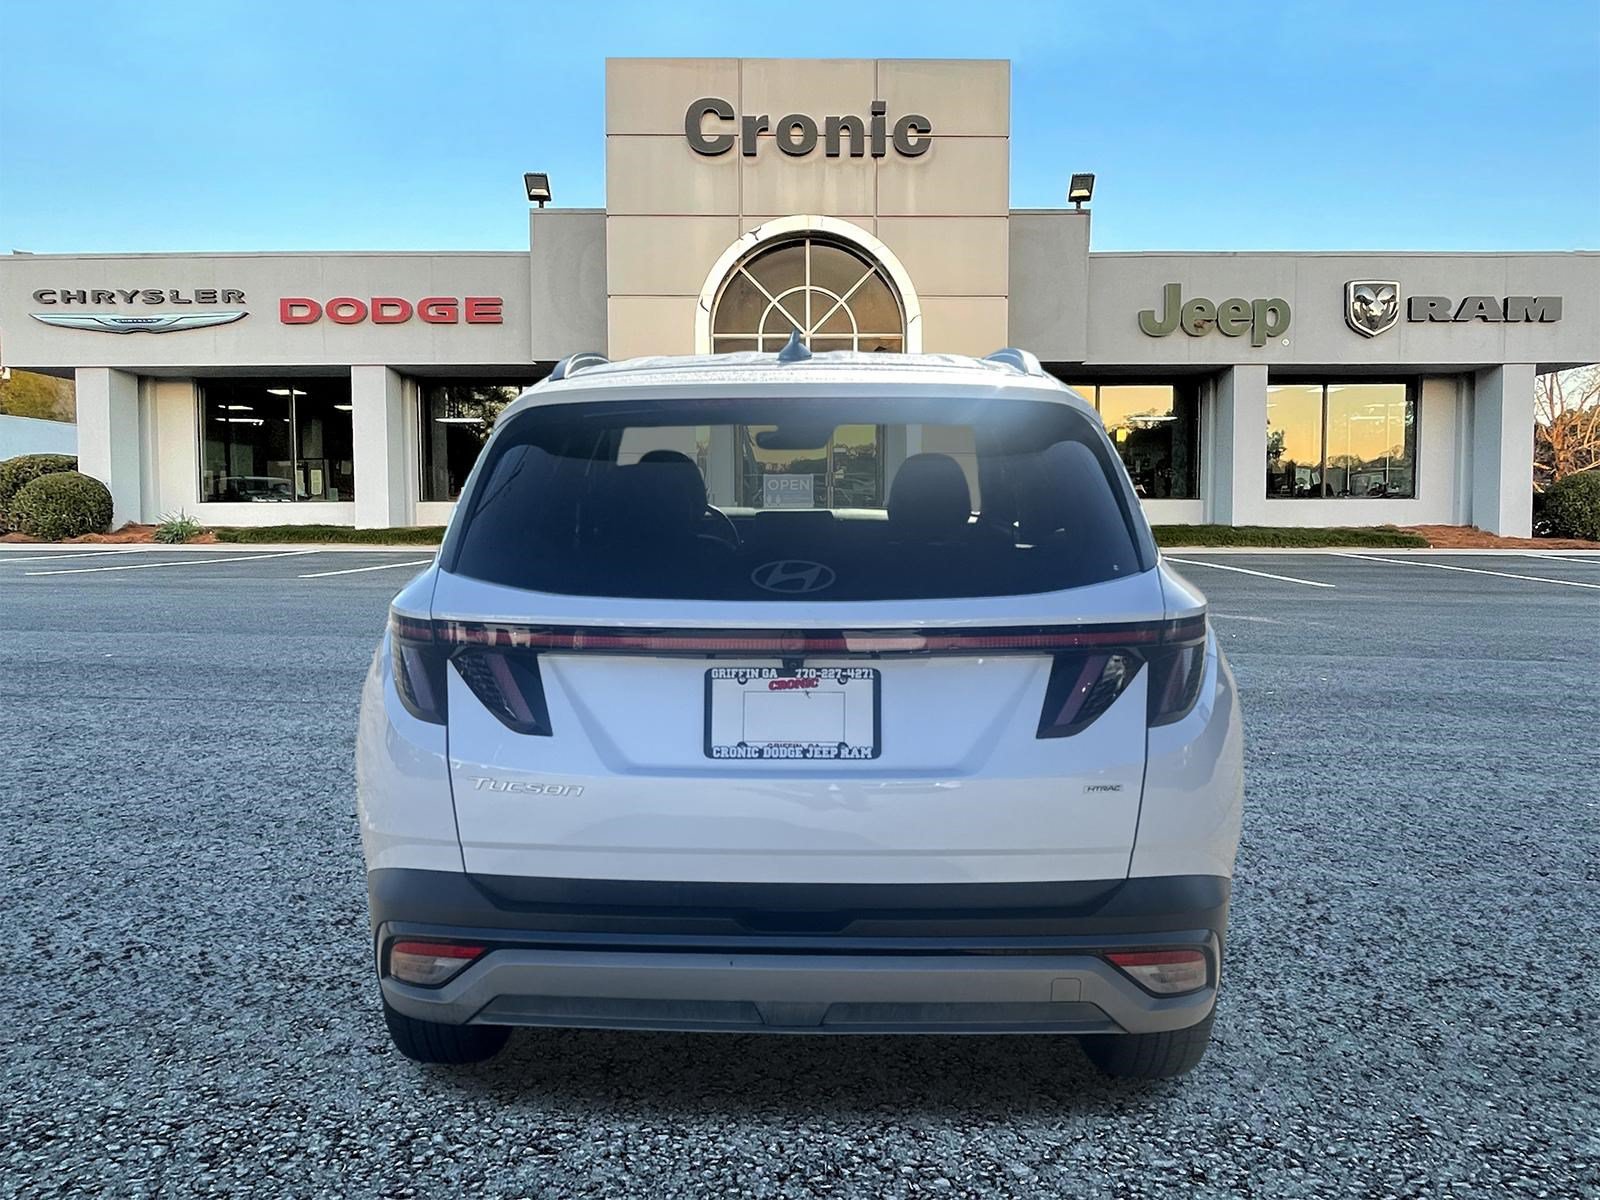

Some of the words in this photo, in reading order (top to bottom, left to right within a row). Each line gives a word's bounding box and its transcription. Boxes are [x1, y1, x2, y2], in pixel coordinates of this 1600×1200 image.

[684, 97, 932, 158] Cronic
[32, 288, 248, 305] CHRYSLER
[279, 297, 504, 325] DODGE
[1138, 283, 1292, 348] Jeep
[1407, 296, 1563, 323] RAM
[767, 479, 810, 491] OPEN
[711, 668, 760, 679] GRIFFIN
[762, 668, 778, 679] GA
[712, 746, 760, 758] CRONIC
[763, 746, 804, 758] DODGE
[806, 746, 838, 758] JEEP
[840, 746, 873, 758] RAM
